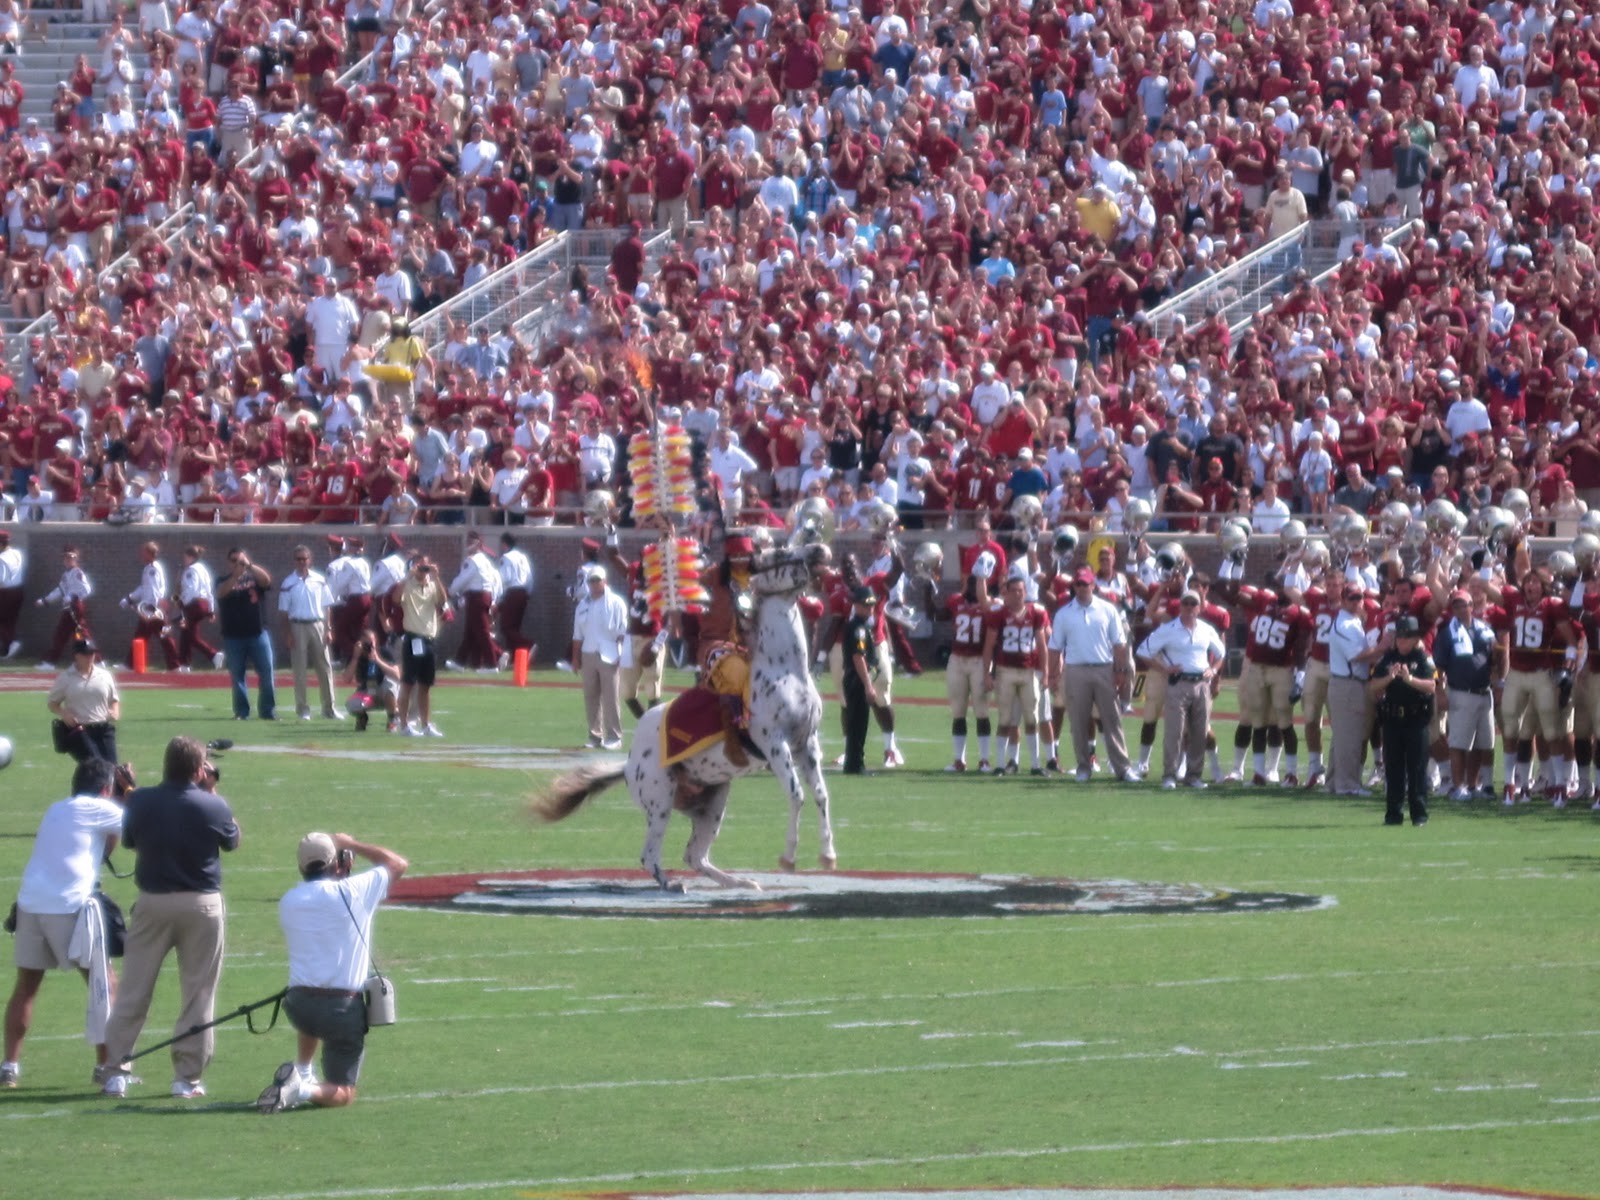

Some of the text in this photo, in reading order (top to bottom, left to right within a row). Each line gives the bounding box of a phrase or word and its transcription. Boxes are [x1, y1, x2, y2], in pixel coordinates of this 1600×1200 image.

[326, 475, 344, 495] 16
[955, 613, 982, 643] 21
[1255, 615, 1290, 650] 85
[1315, 614, 1332, 643] 2
[1514, 615, 1543, 648] 19
